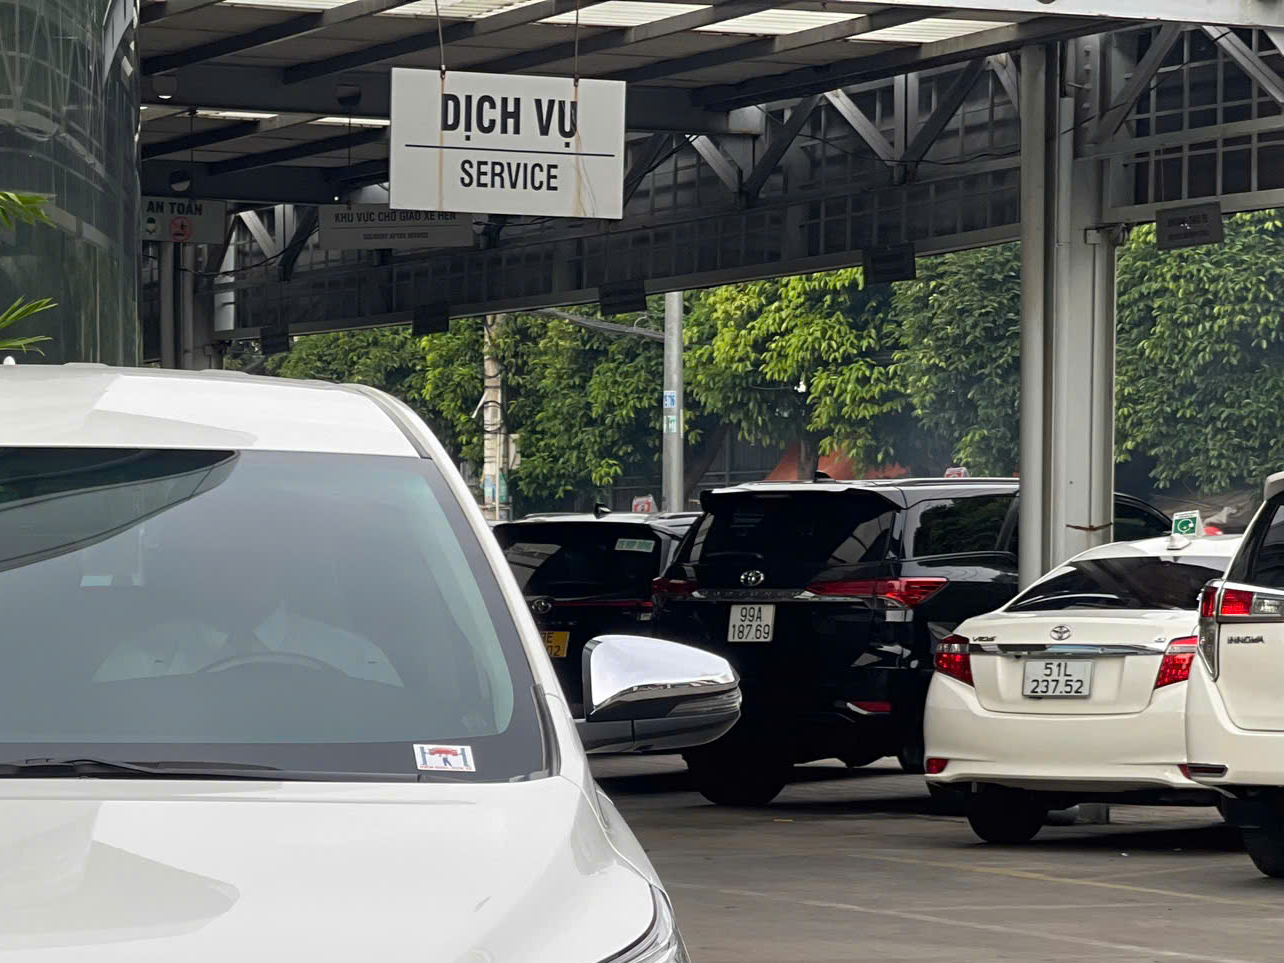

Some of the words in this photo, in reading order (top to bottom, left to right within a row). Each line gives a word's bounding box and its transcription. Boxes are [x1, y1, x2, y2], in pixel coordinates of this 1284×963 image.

[441, 93, 521, 141] DỊCH
[534, 98, 578, 148] VỤ
[460, 159, 559, 191] SERVICE
[334, 212, 354, 223] KHU
[739, 606, 763, 623] 99A
[731, 623, 771, 640] 187.69
[1043, 662, 1072, 677] 51L
[1030, 679, 1084, 694] 237.52
